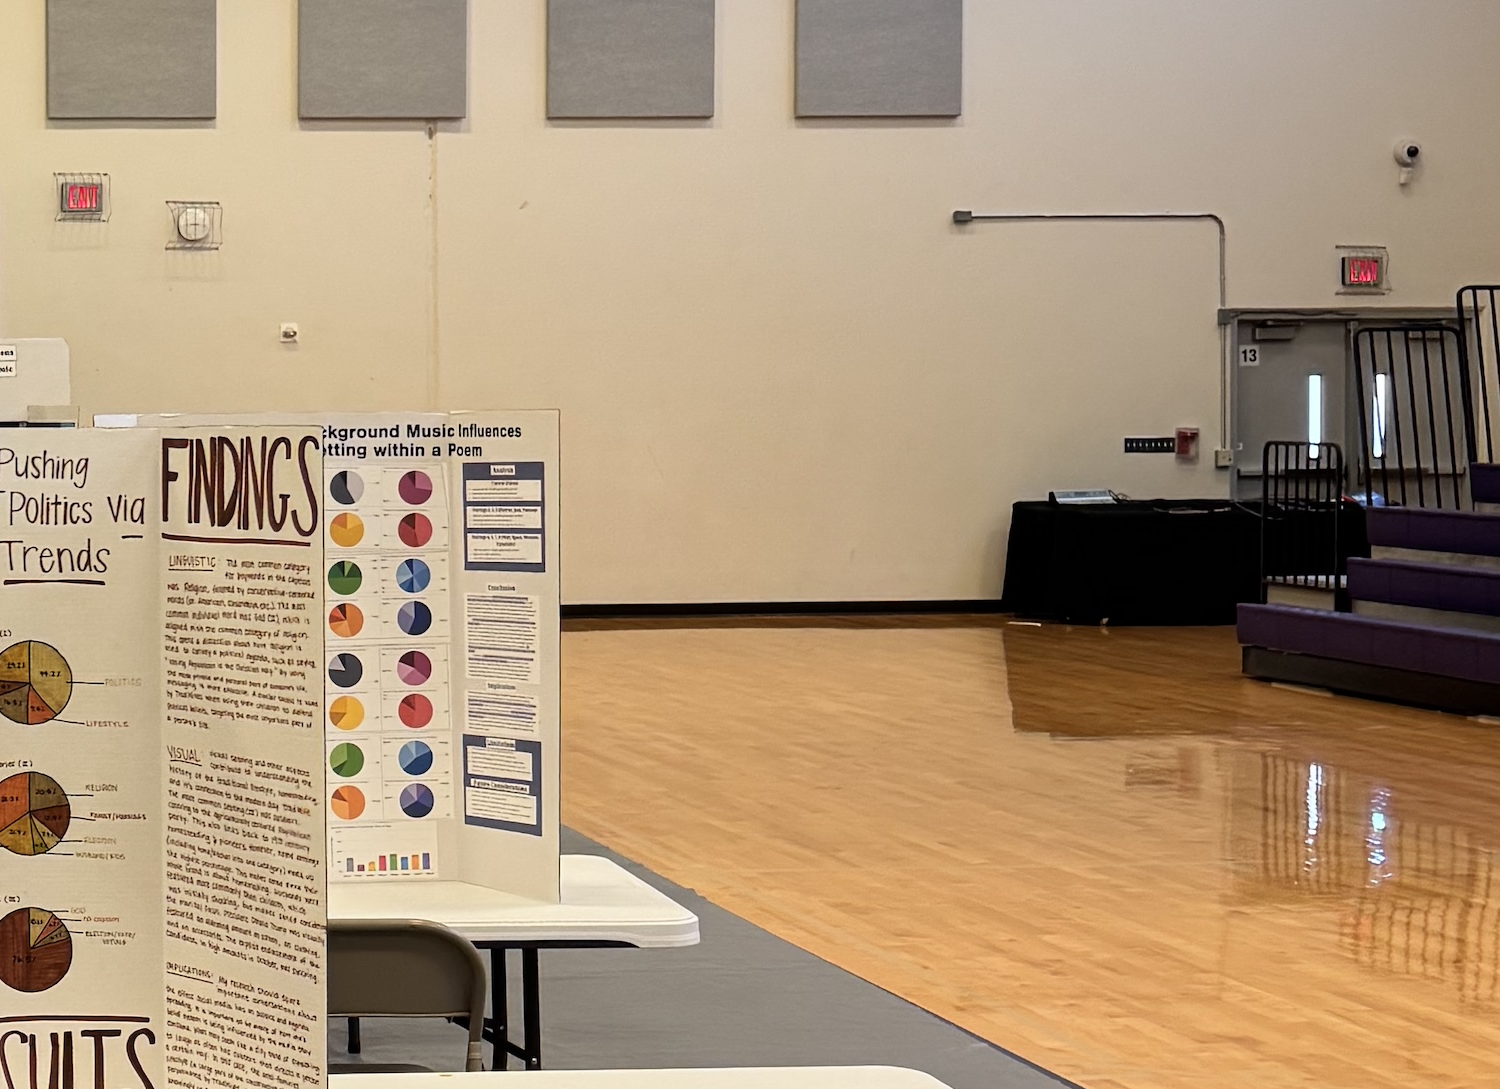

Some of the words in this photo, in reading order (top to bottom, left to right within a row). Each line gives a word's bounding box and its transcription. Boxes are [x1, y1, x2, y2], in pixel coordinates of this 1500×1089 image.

[1241, 348, 1257, 363] 13
[323, 425, 400, 441] kground
[407, 424, 454, 437] Music
[459, 424, 521, 437] Influences
[323, 443, 366, 458] tting
[374, 443, 425, 457] within
[432, 445, 441, 456] a
[449, 444, 482, 457] Poem
[162, 436, 320, 537] FINDINGS
[9, 491, 92, 526] Politics
[167, 745, 201, 762] VISUAL
